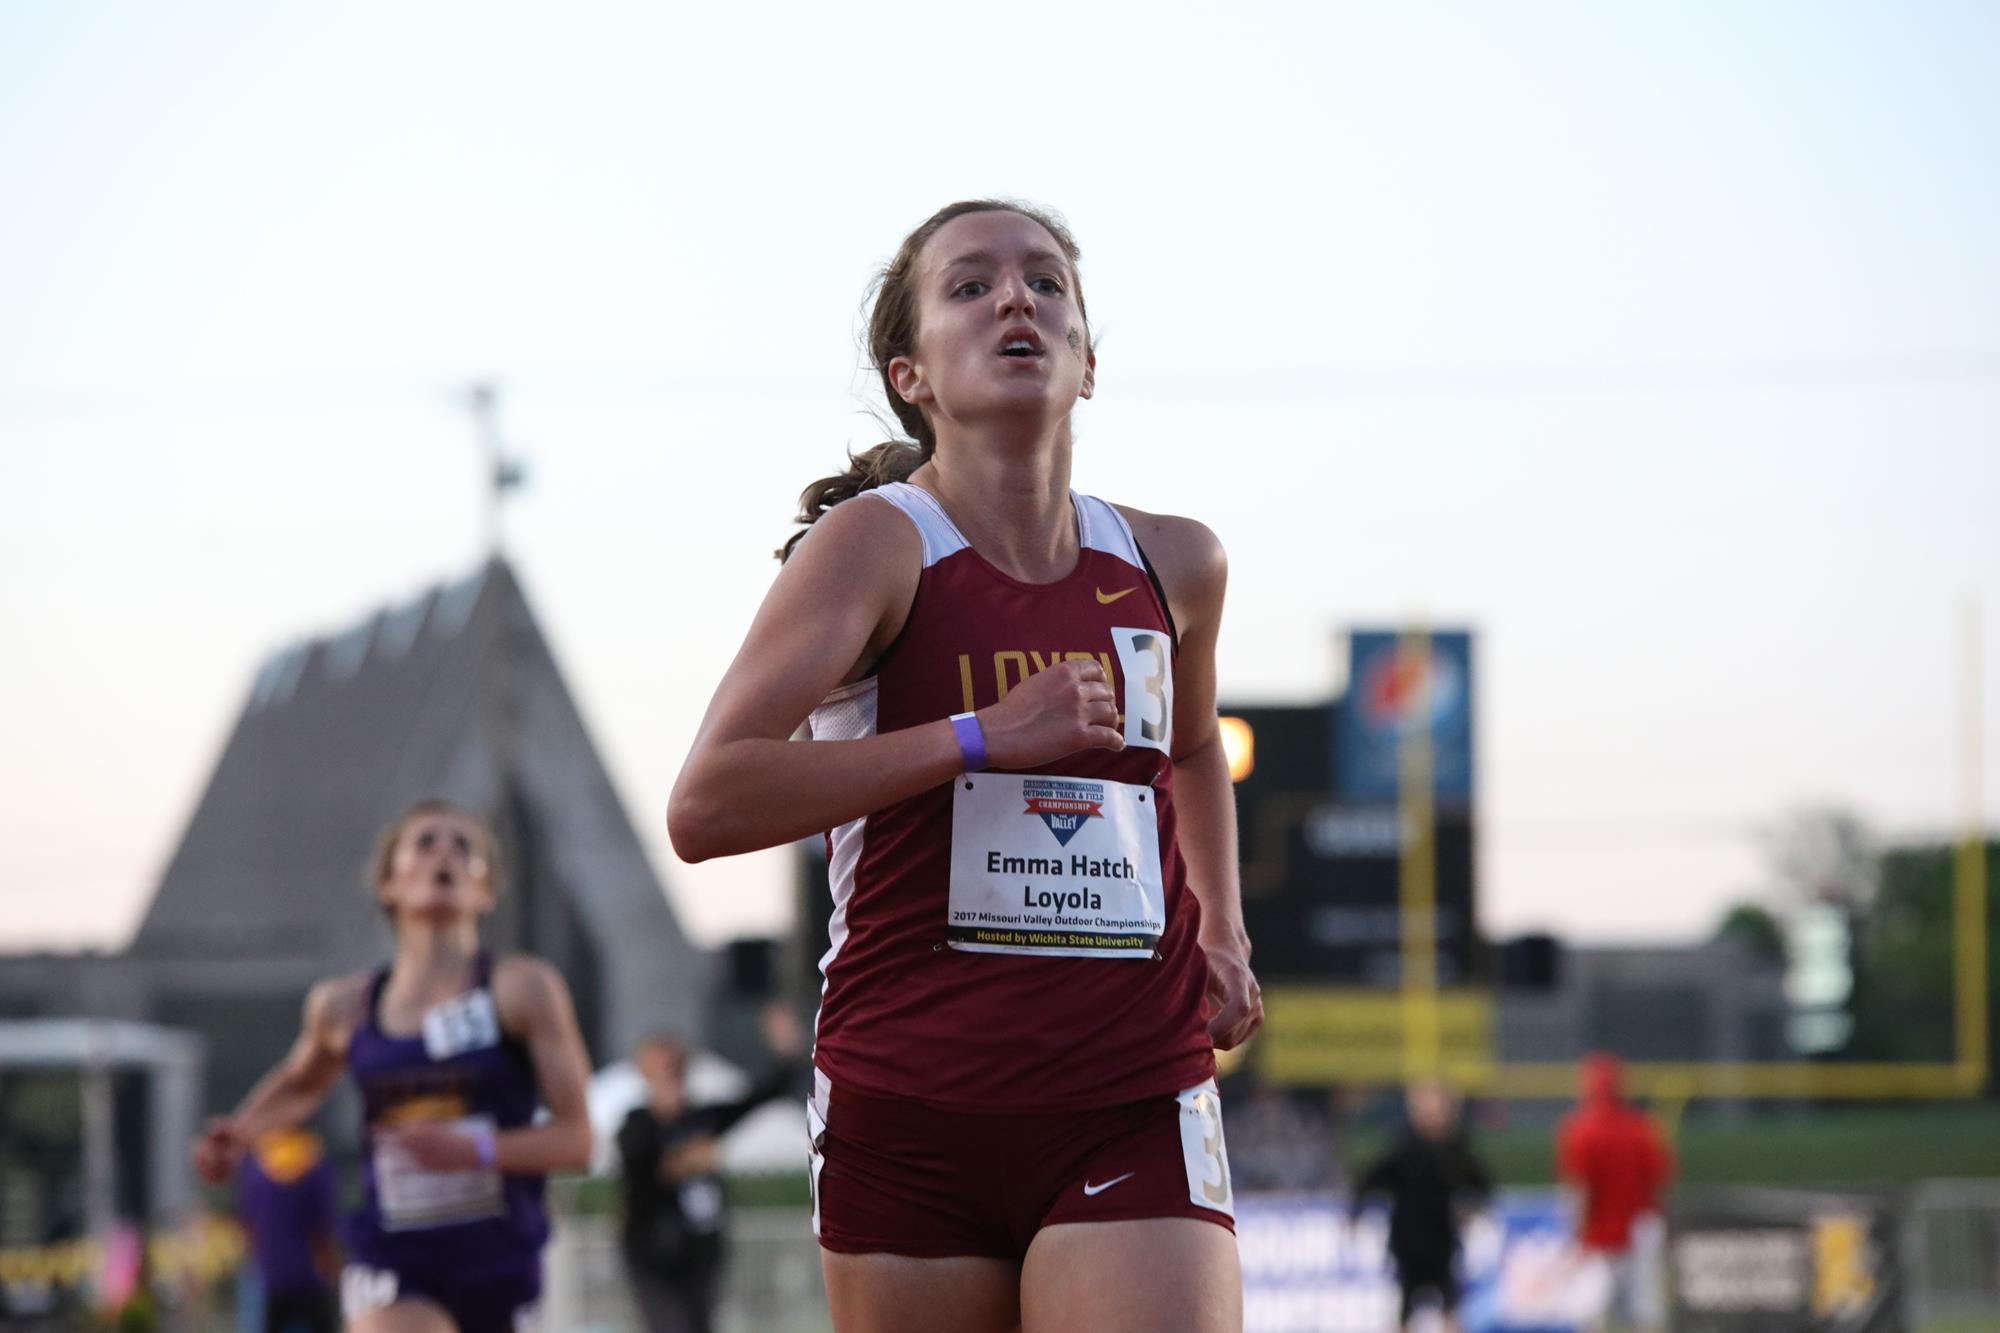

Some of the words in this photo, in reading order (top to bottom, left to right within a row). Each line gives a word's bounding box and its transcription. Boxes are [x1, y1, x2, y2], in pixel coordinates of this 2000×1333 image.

[1131, 634, 1168, 743] 3
[1023, 789, 1054, 798] OUTDOOR
[1056, 791, 1077, 800] TRACK
[1086, 793, 1105, 801] FIELD
[1052, 782, 1070, 790] VALLEY
[1038, 800, 1091, 811] CHAMPIONSHIP
[1051, 813, 1078, 830] VALLEY
[986, 851, 1063, 875] Emma
[1071, 855, 1135, 879] Hatch
[1024, 886, 1102, 914] Loyola
[953, 911, 977, 921] 2017
[978, 912, 1021, 924] Missouri
[1023, 914, 1053, 927] Valley
[1055, 915, 1094, 927] Outdoor
[1094, 919, 1161, 931] Championships
[976, 930, 1012, 943] Hosted
[1014, 932, 1027, 945] by
[1029, 932, 1067, 945] Wichita
[1069, 934, 1095, 946] State
[1095, 935, 1144, 948] University
[1193, 1092, 1228, 1205] 3
